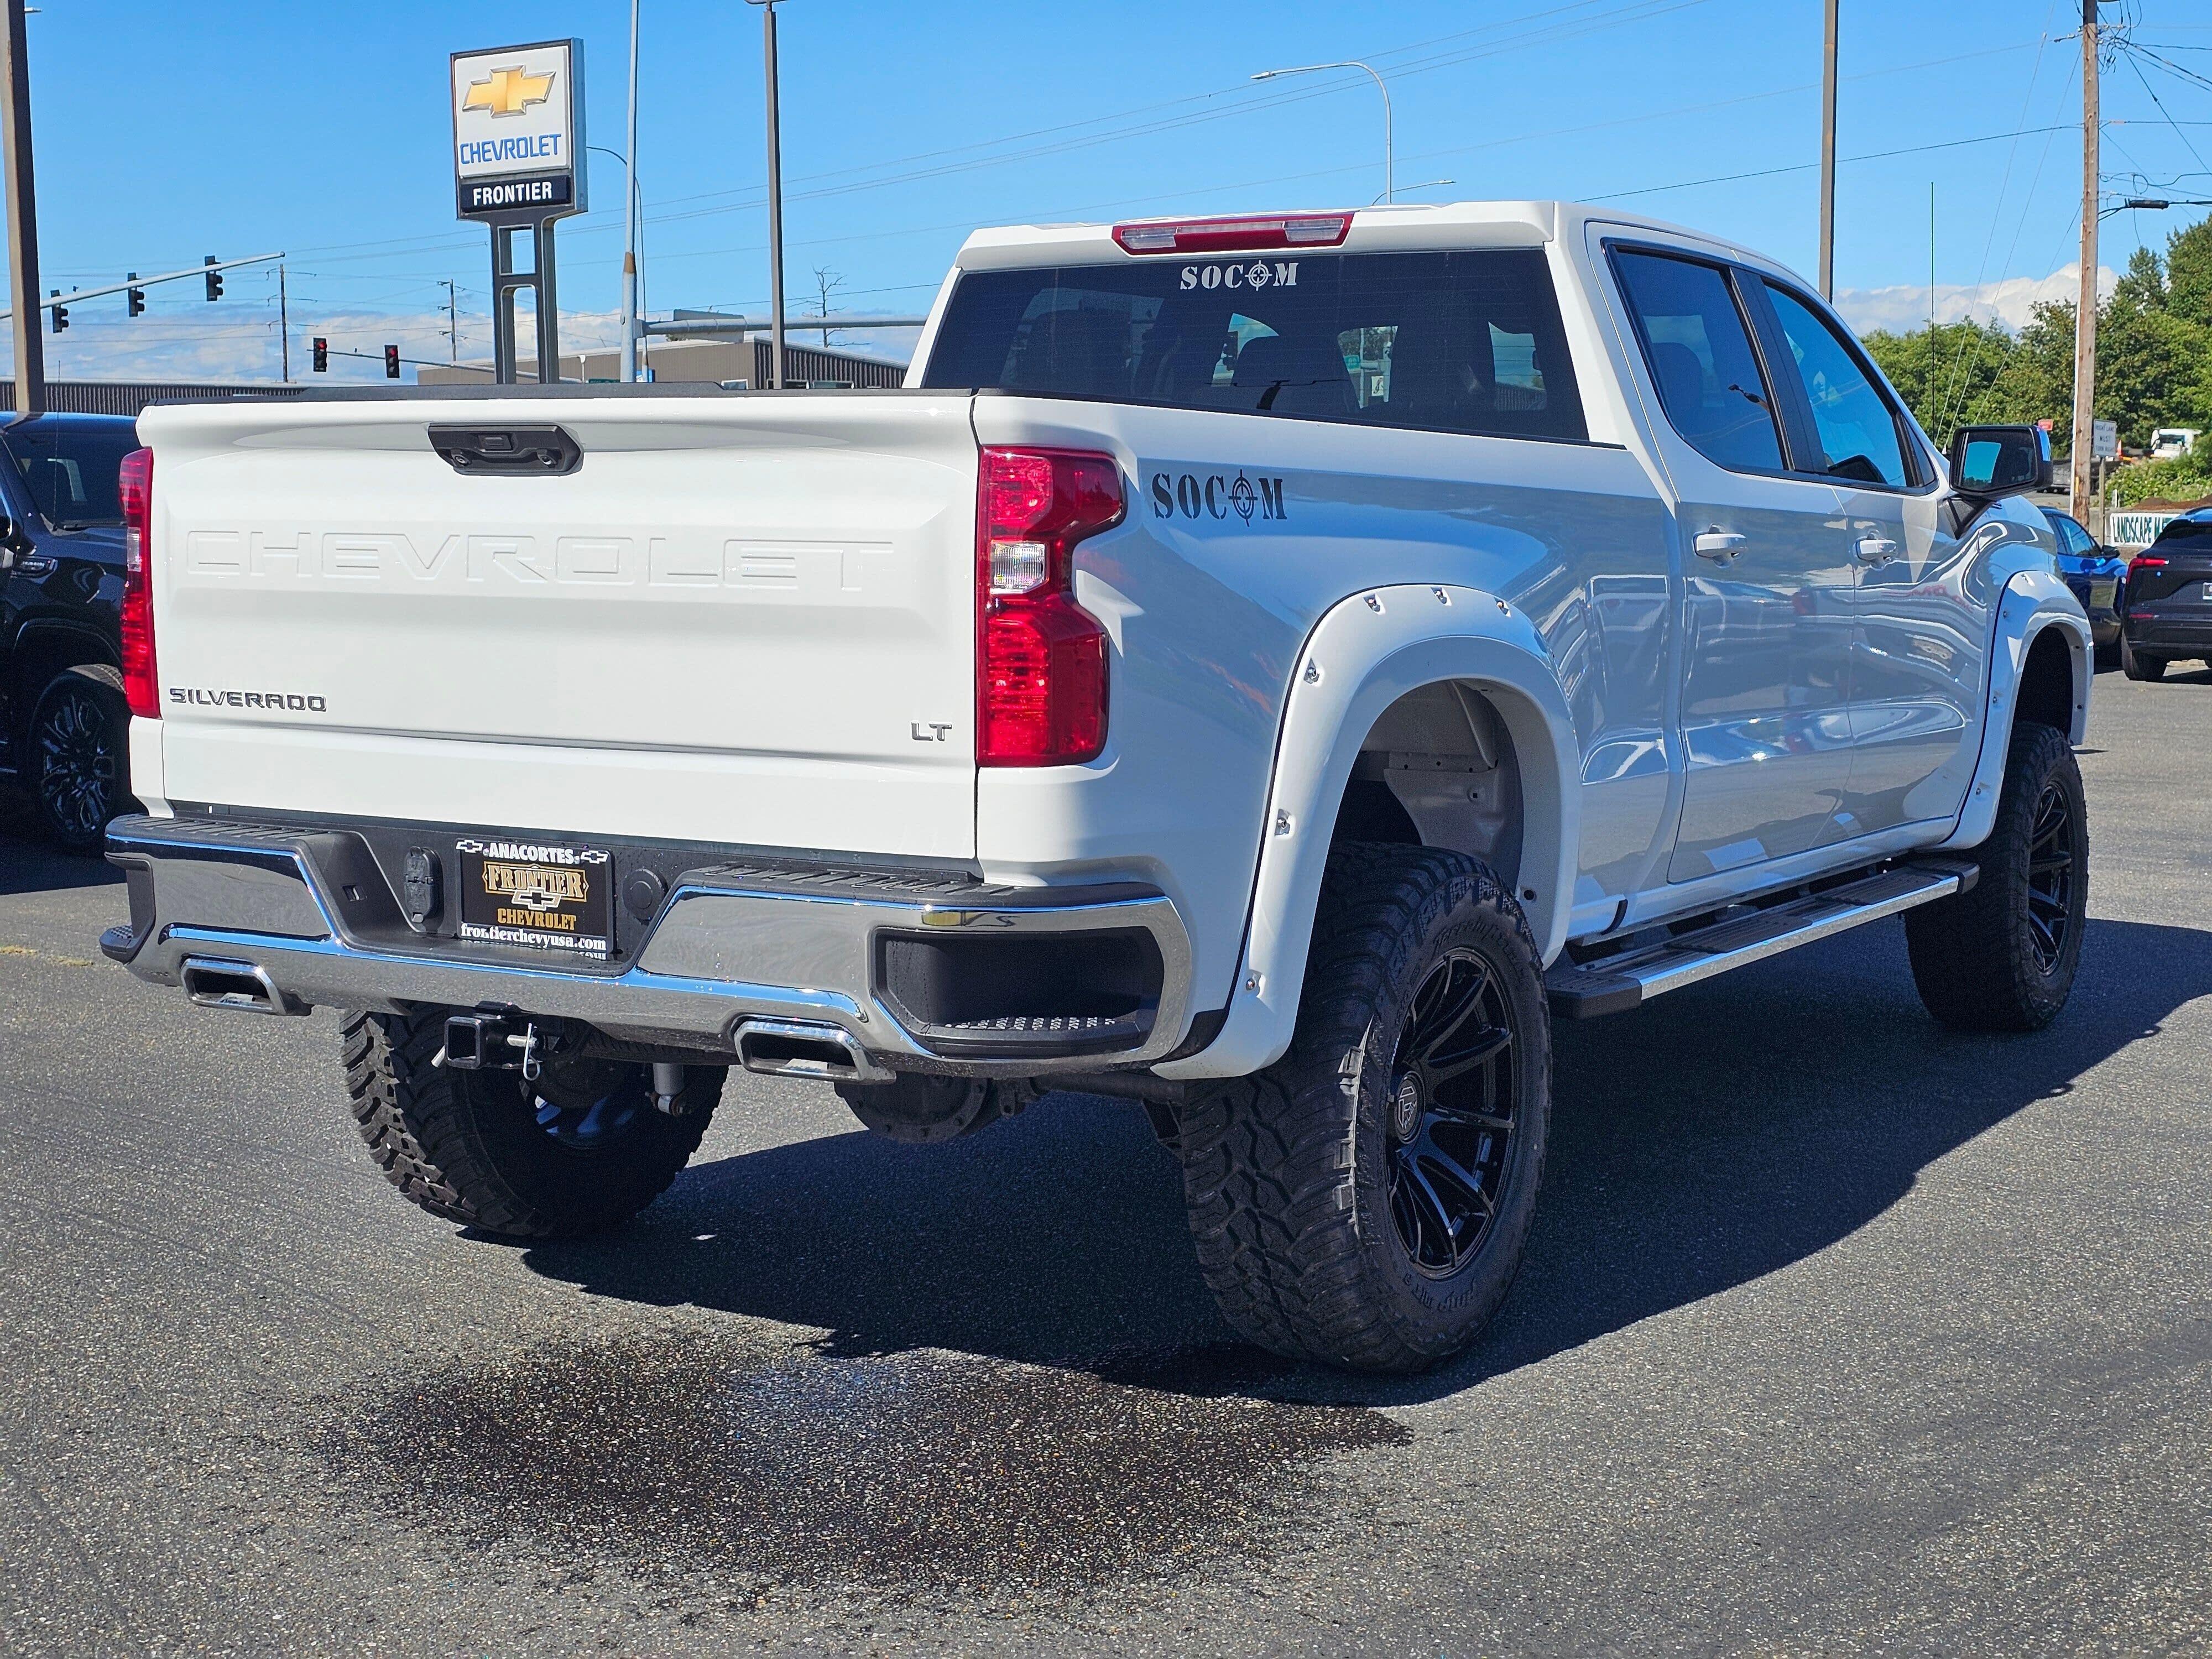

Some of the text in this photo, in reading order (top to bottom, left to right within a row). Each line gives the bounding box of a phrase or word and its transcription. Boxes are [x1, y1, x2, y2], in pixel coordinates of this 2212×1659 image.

[460, 133, 561, 164] CHEVROLET
[473, 181, 552, 206] FRONTIER
[2112, 517, 2152, 544] LANDSCAPE
[187, 530, 894, 591] CHEVROLET
[169, 687, 327, 712] SILVERADO
[910, 721, 952, 742] LT
[489, 842, 575, 864] ANACORTES
[488, 864, 585, 899] FRONTIER
[497, 908, 577, 931] CHEVROLET
[461, 923, 607, 951] frontierchevyusa.com
